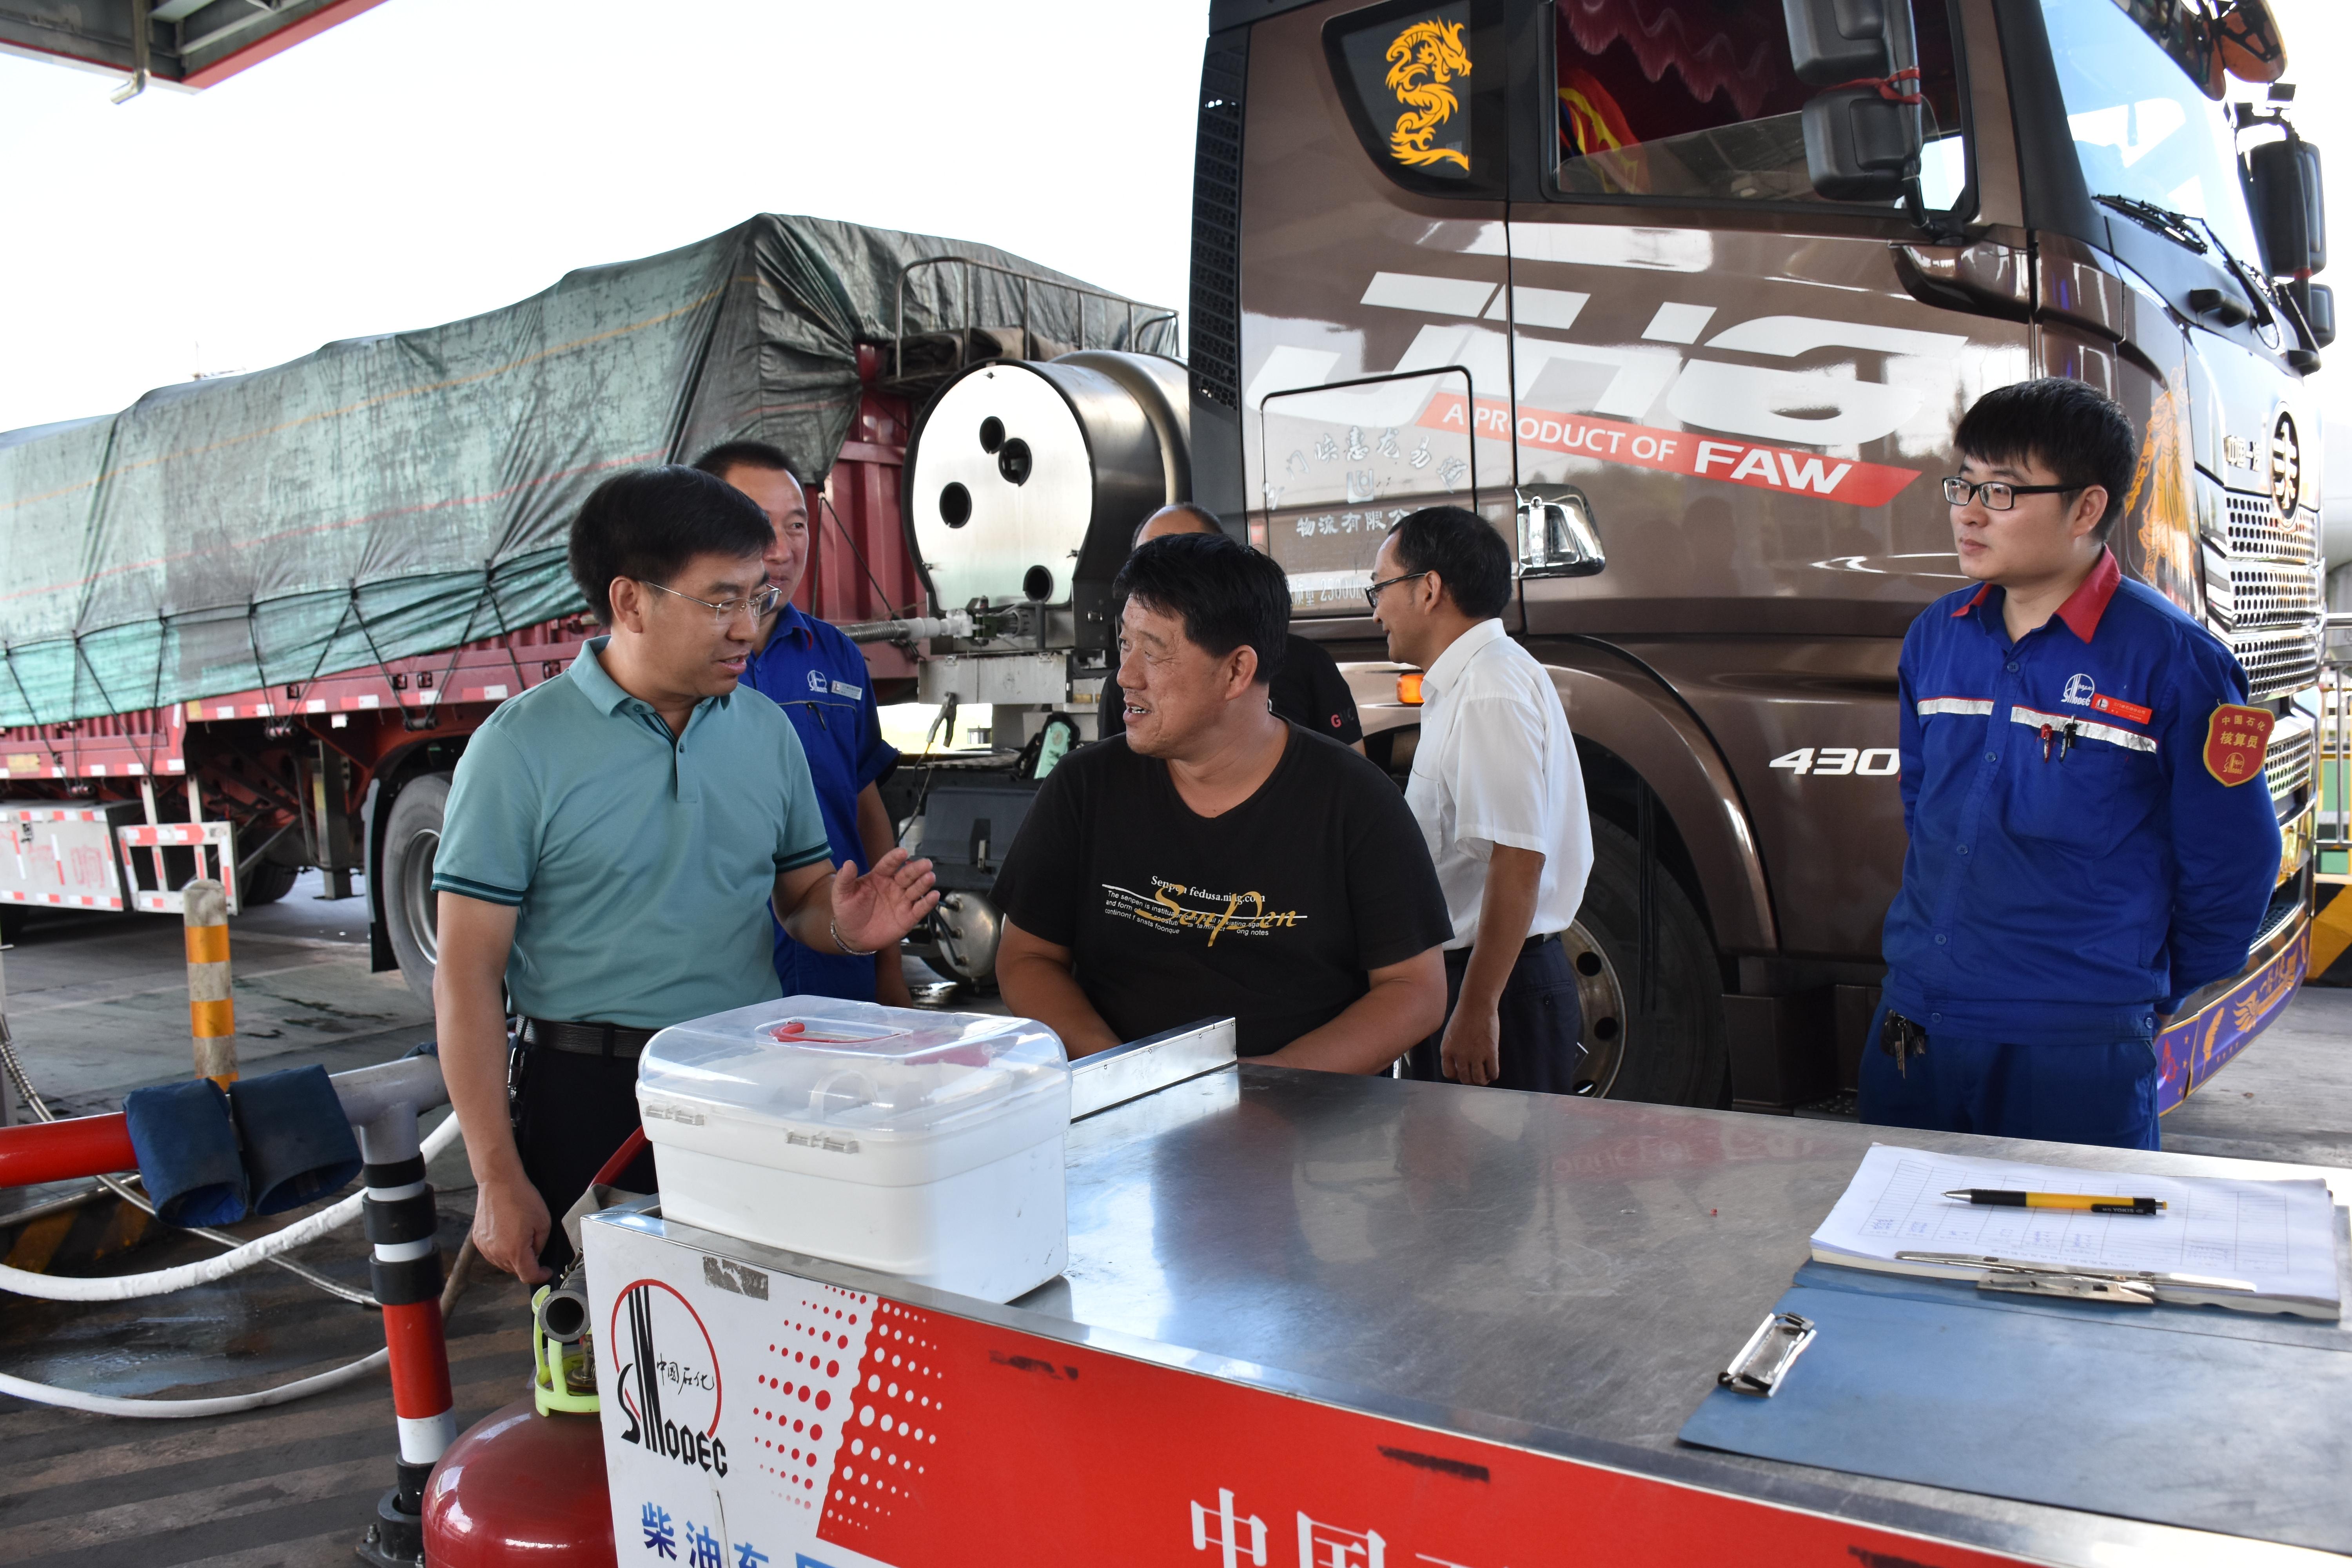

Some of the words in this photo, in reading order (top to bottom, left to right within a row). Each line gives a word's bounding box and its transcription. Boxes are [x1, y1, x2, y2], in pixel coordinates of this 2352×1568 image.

[1442, 403, 1464, 425] A
[1474, 407, 1626, 454] PRODUCT
[1631, 436, 1677, 461] OF
[1693, 441, 1852, 494] FAW
[1296, 507, 1425, 537] 物流有限公
[2221, 715, 2265, 731] 中国石化
[2220, 731, 2259, 748] 核算员
[1769, 748, 1900, 775] 430
[1108, 890, 1119, 898] The
[1120, 893, 1143, 907] senpen
[1118, 902, 1132, 911] form
[617, 1285, 728, 1478] SINOPEC
[641, 1501, 841, 1568] 柴油
